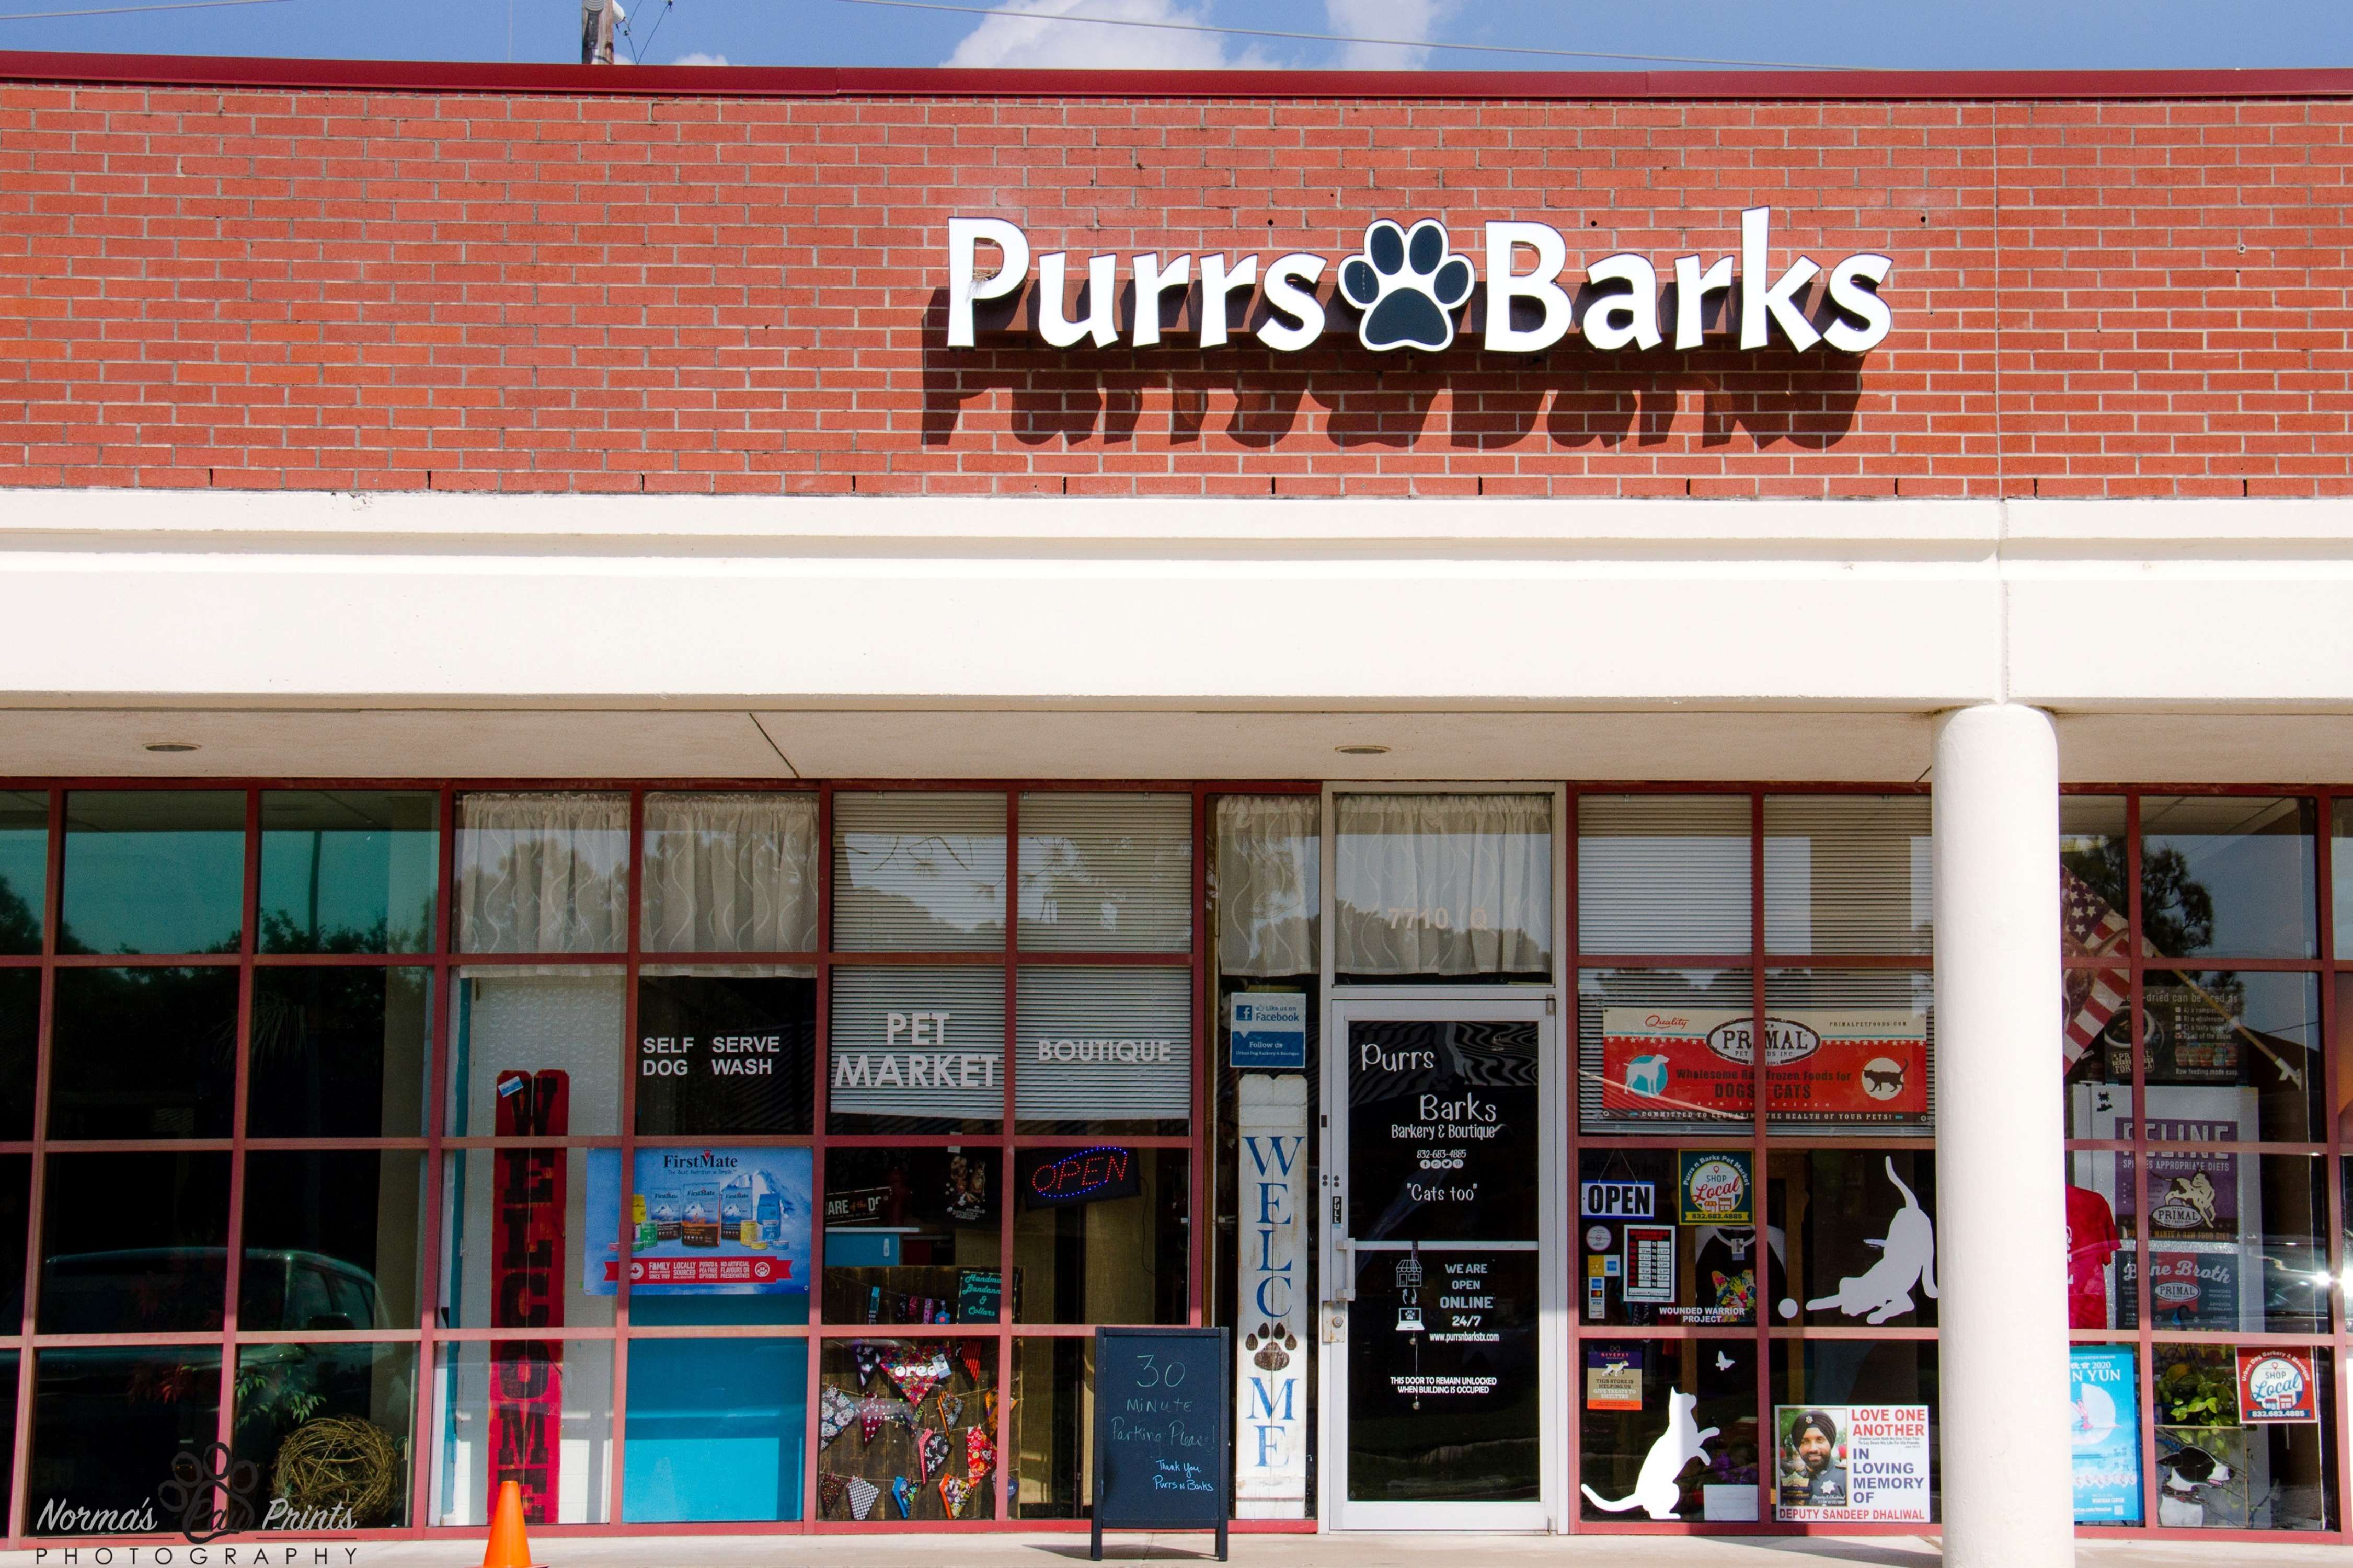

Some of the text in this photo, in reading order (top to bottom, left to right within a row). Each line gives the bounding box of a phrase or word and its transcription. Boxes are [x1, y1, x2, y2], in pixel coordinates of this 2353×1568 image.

[947, 206, 1894, 353] Purrs Barks
[1388, 907, 1487, 931] 7710 Q
[2192, 993, 2201, 1002] be
[1256, 1012, 1299, 1021] Facebook
[1645, 1014, 1690, 1030] Quality
[888, 1013, 949, 1045] PET
[643, 1037, 779, 1053] SELF SERVE
[1722, 1031, 1808, 1051] PRMAL
[1038, 1039, 1171, 1063] BOUTIQUE
[1361, 1044, 1434, 1071] Purrs
[643, 1059, 772, 1076] DOG WASH
[835, 1054, 998, 1087] MARKET
[1677, 1069, 1738, 1080] Wholesome
[1804, 1070, 1833, 1081] Foods
[1837, 1070, 1852, 1081] for
[1715, 1083, 1811, 1098] DOGS CATS
[1420, 1092, 1497, 1122] Barks
[1391, 1124, 1495, 1140] Barkery & Boutique
[1417, 1150, 1466, 1158] 832-683-4885
[663, 1154, 738, 1168] FirstMate
[2208, 1162, 2229, 1171] DIETS
[1032, 1154, 1127, 1191] OPEN
[1683, 1167, 1695, 1185] Purrs
[1699, 1155, 1720, 1164] Barks
[1721, 1155, 1734, 1166] Pet
[1734, 1161, 1750, 1186] Market
[1690, 1175, 1740, 1203] Local
[1588, 1184, 1650, 1214] OPEN
[2159, 1210, 2197, 1220] PRIMAL
[649, 1262, 670, 1270] FAMILY
[1445, 1264, 1487, 1273] WE ARE
[2123, 1260, 2231, 1284] Bne Broth
[965, 1274, 1002, 1283] Handma
[1452, 1280, 1480, 1290] OPEN
[2160, 1286, 2195, 1295] PRIMAL
[1440, 1296, 1493, 1308] ONLINE
[968, 1306, 995, 1316] Collars
[1452, 1315, 1482, 1328] 24/7
[1429, 1332, 1499, 1343] www.purrsnbarkstx.com
[1137, 1354, 1185, 1387] 30
[2242, 1364, 2252, 1381] Urban
[2250, 1355, 2262, 1365] Dog
[2292, 1356, 2310, 1381] Boutique
[1436, 1377, 1461, 1385] REMAIN
[1462, 1377, 1497, 1385] UNLOCKED
[2086, 1369, 2121, 1381] YUN
[2251, 1371, 2300, 1400] Local
[1851, 1409, 1925, 1421] LOVE ONE
[1111, 1417, 1162, 1453] Parking
[1853, 1424, 1924, 1436] ANOTHER
[1853, 1448, 1869, 1460] IN
[1156, 1459, 1180, 1472] Thank
[1853, 1463, 1914, 1474] LOVING
[1153, 1475, 1177, 1490] Purrs
[1853, 1477, 1924, 1489] MEMORY
[1853, 1492, 1874, 1503] OF
[1779, 1509, 1924, 1520] DEPUTY SANDEEP DHALIWAL
